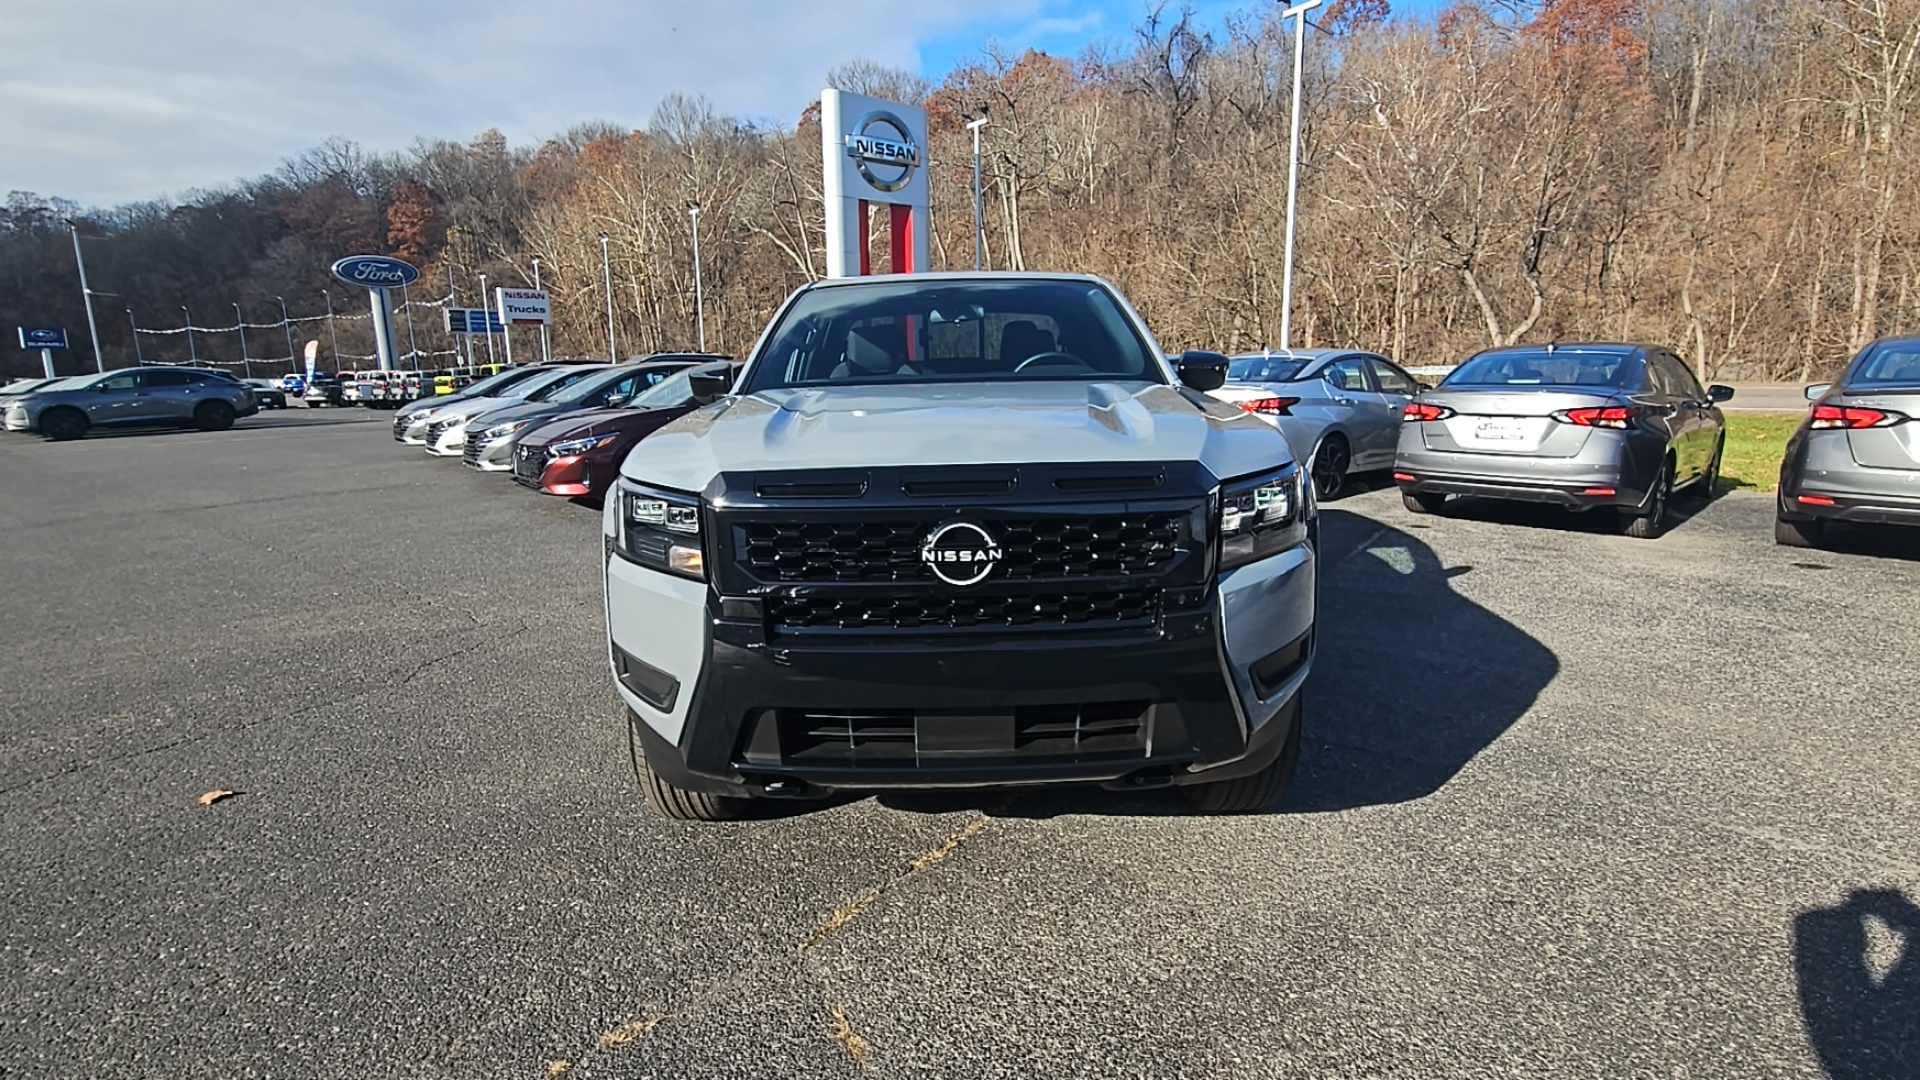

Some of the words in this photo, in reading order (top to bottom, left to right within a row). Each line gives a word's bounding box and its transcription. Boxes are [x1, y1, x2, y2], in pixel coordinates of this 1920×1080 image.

[856, 139, 916, 161] NISSAN
[354, 262, 402, 280] Ford
[504, 291, 545, 300] NISSAN
[507, 305, 546, 314] Trucks
[922, 549, 1002, 562] NISSAN
